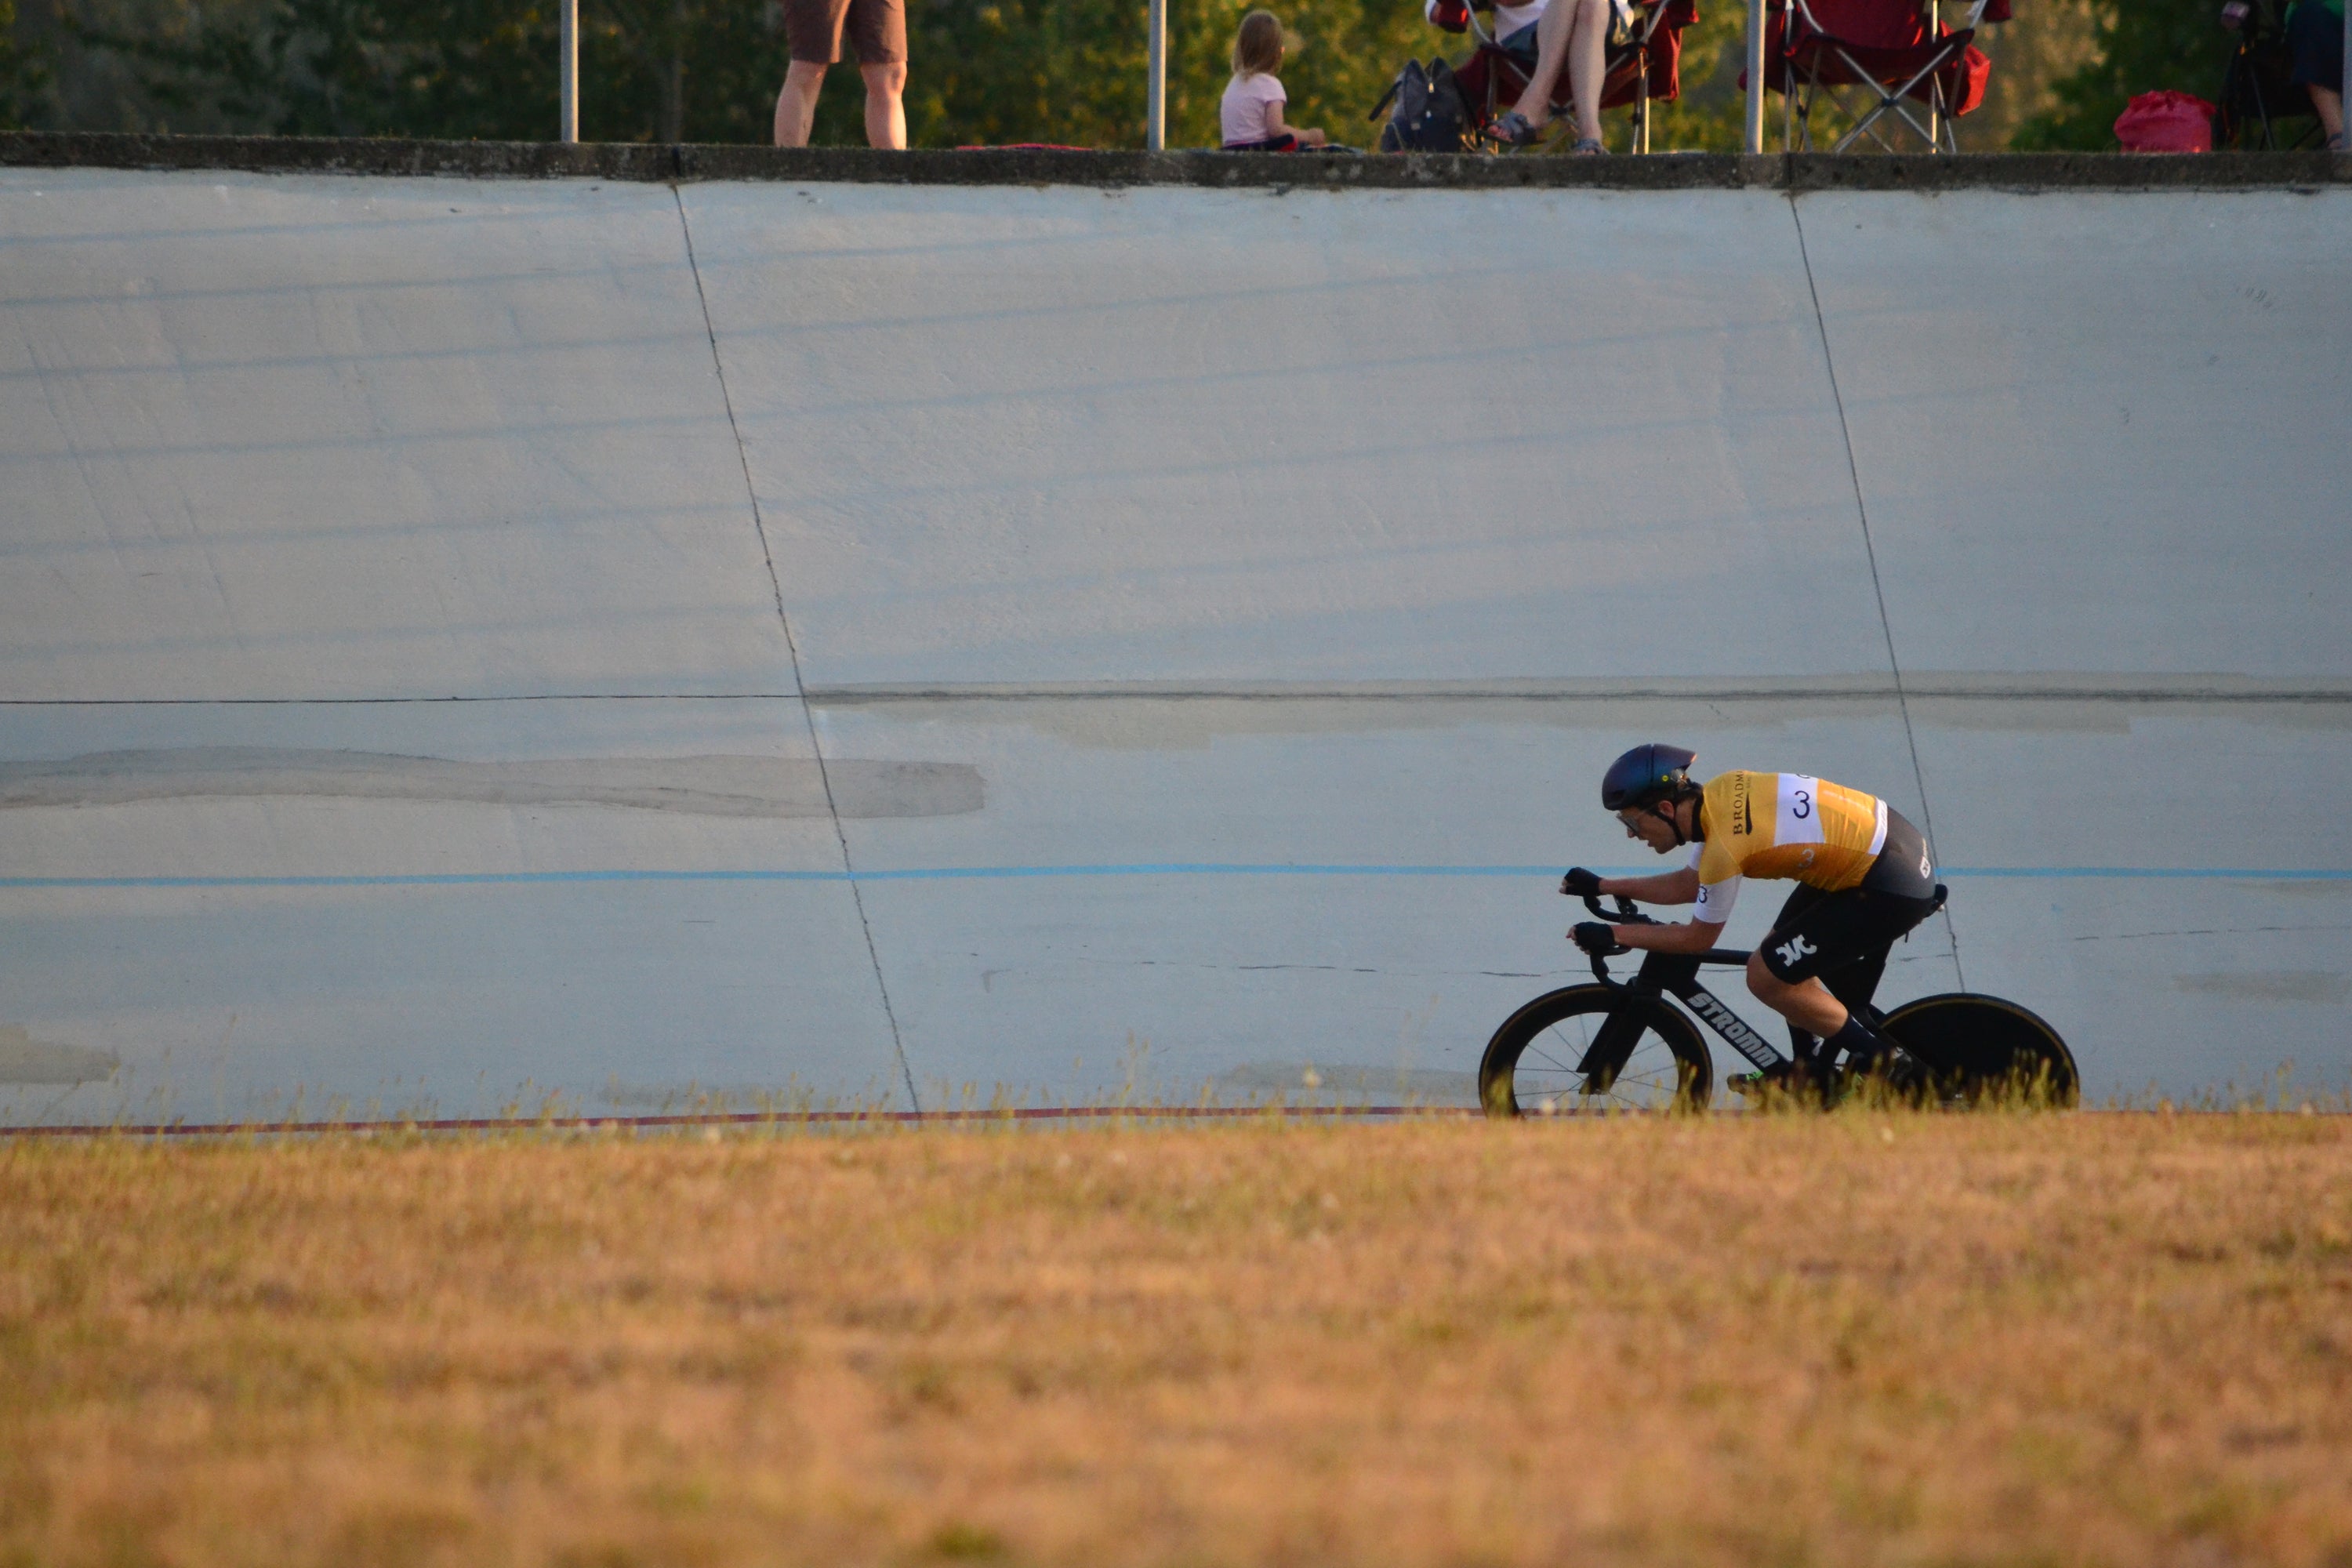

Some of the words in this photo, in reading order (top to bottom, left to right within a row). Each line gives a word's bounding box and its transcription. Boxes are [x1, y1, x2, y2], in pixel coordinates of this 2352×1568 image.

[1733, 771, 1744, 836] BROADM
[1793, 790, 1810, 819] 3
[1699, 886, 1708, 903] 3
[1687, 992, 1779, 1068] STROMM
